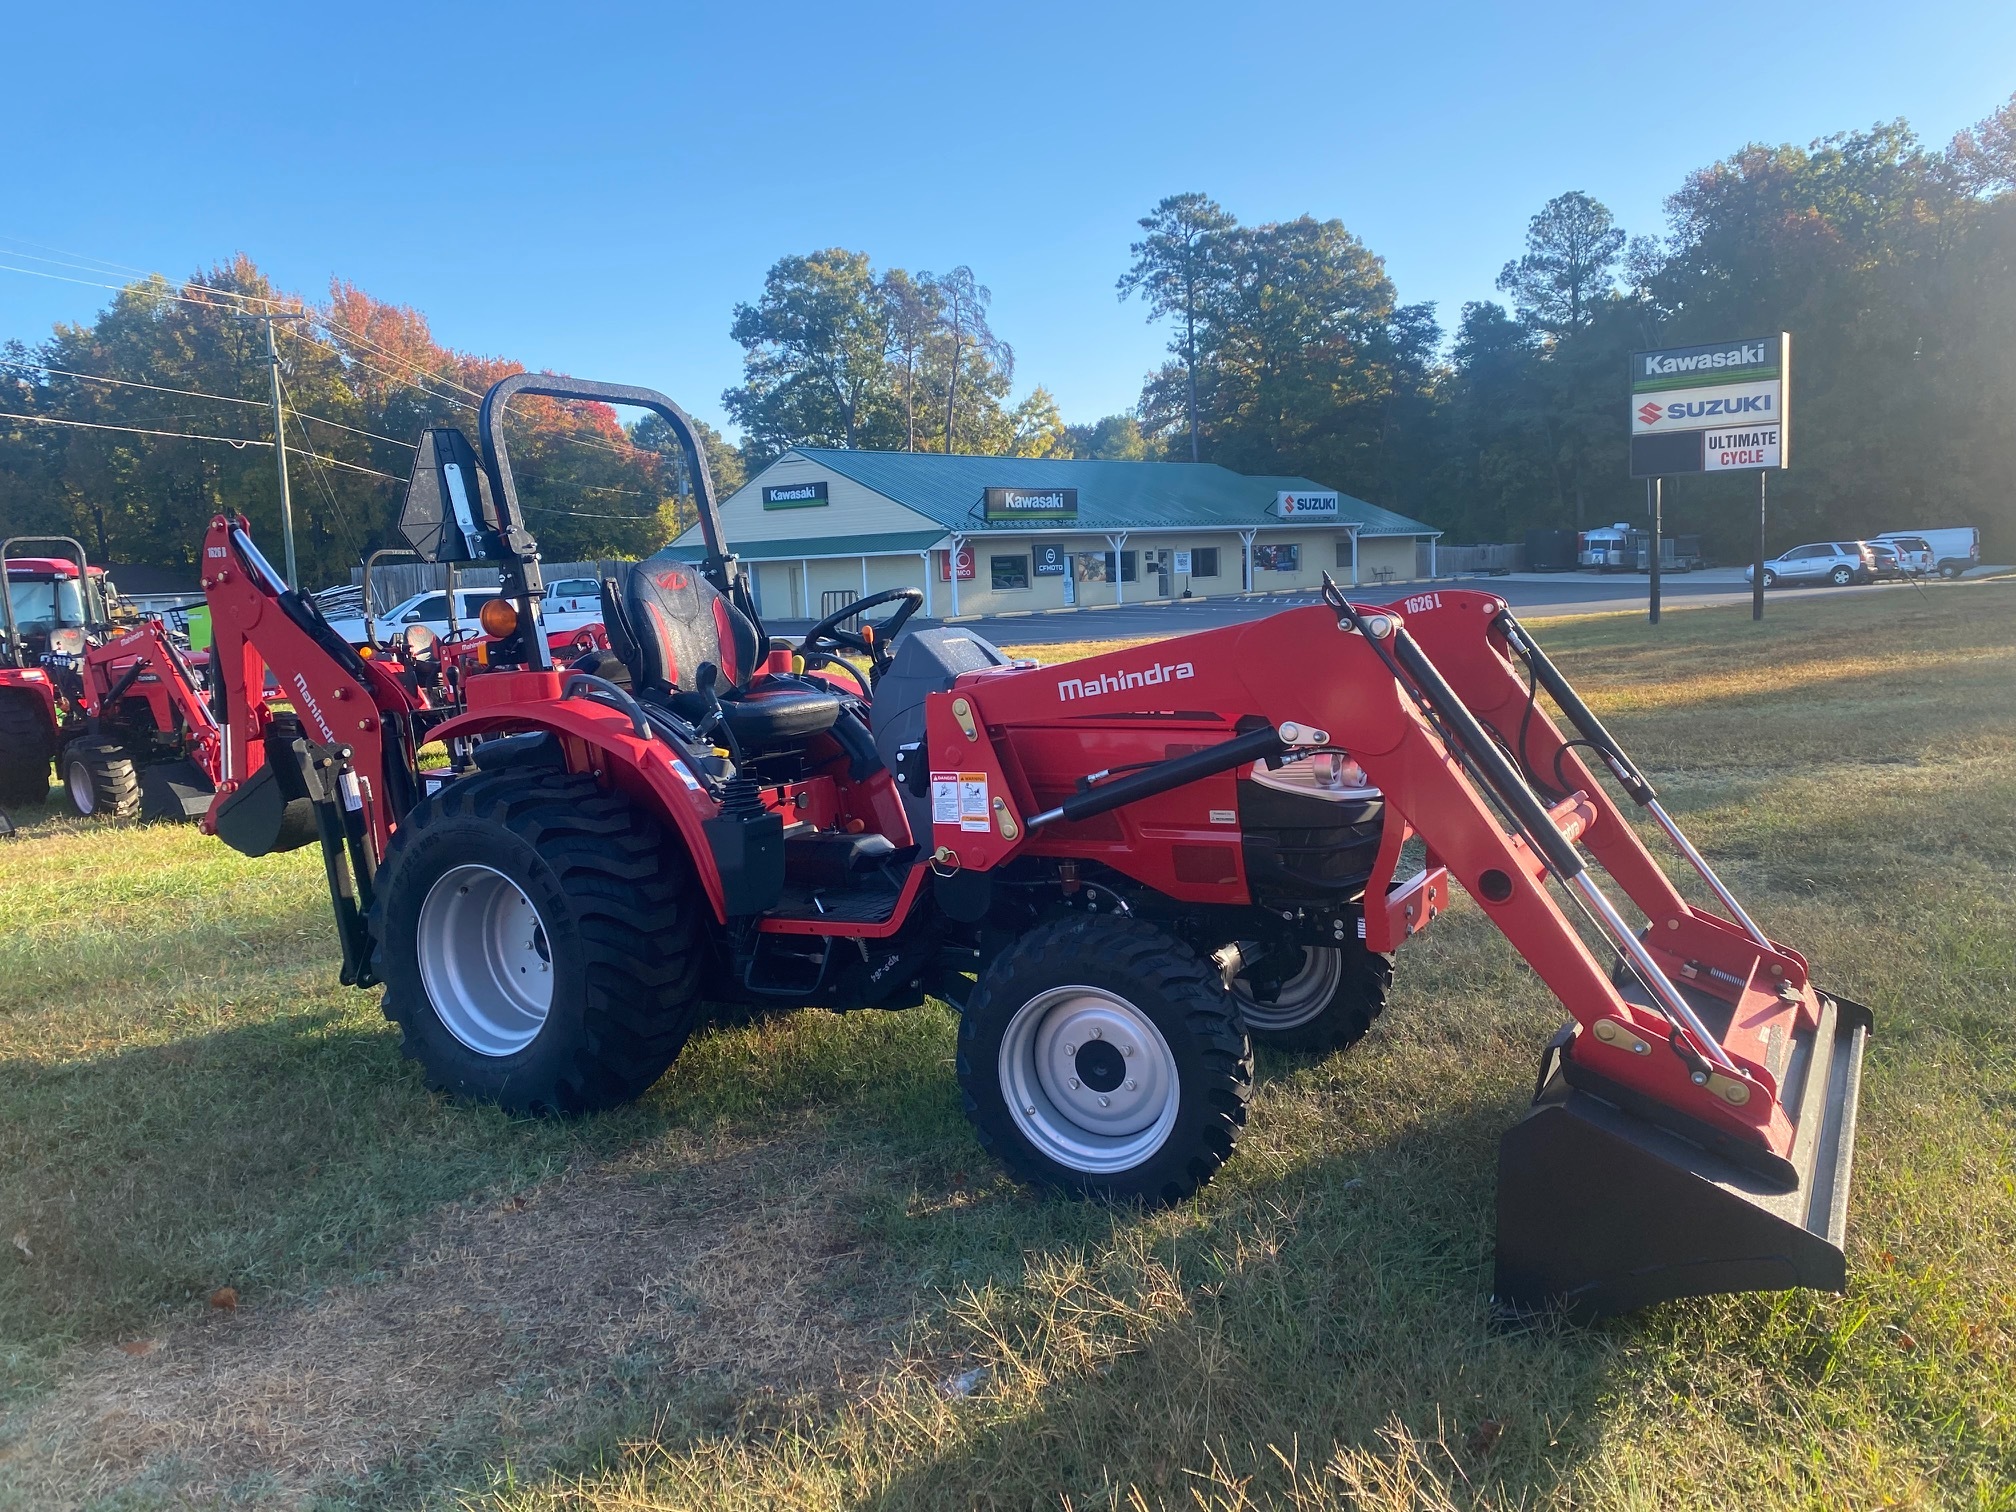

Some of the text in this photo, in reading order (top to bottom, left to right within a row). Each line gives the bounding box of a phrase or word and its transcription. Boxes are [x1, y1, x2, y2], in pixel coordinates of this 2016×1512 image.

[1646, 343, 1765, 375] Kawasaki
[1667, 394, 1771, 420] SUZUKI
[1709, 431, 1776, 450] ULTIMATE
[1721, 449, 1764, 466] CYCLE
[770, 486, 815, 501] Kawasaki
[1005, 492, 1064, 508] Kawasaki
[1296, 498, 1336, 511] SUZUKI
[206, 546, 222, 559] 1626
[1038, 564, 1064, 572] CFMOTO
[1404, 593, 1443, 614] 1626 L
[1057, 662, 1195, 702] Mahindra
[293, 672, 336, 744] Mahindr
